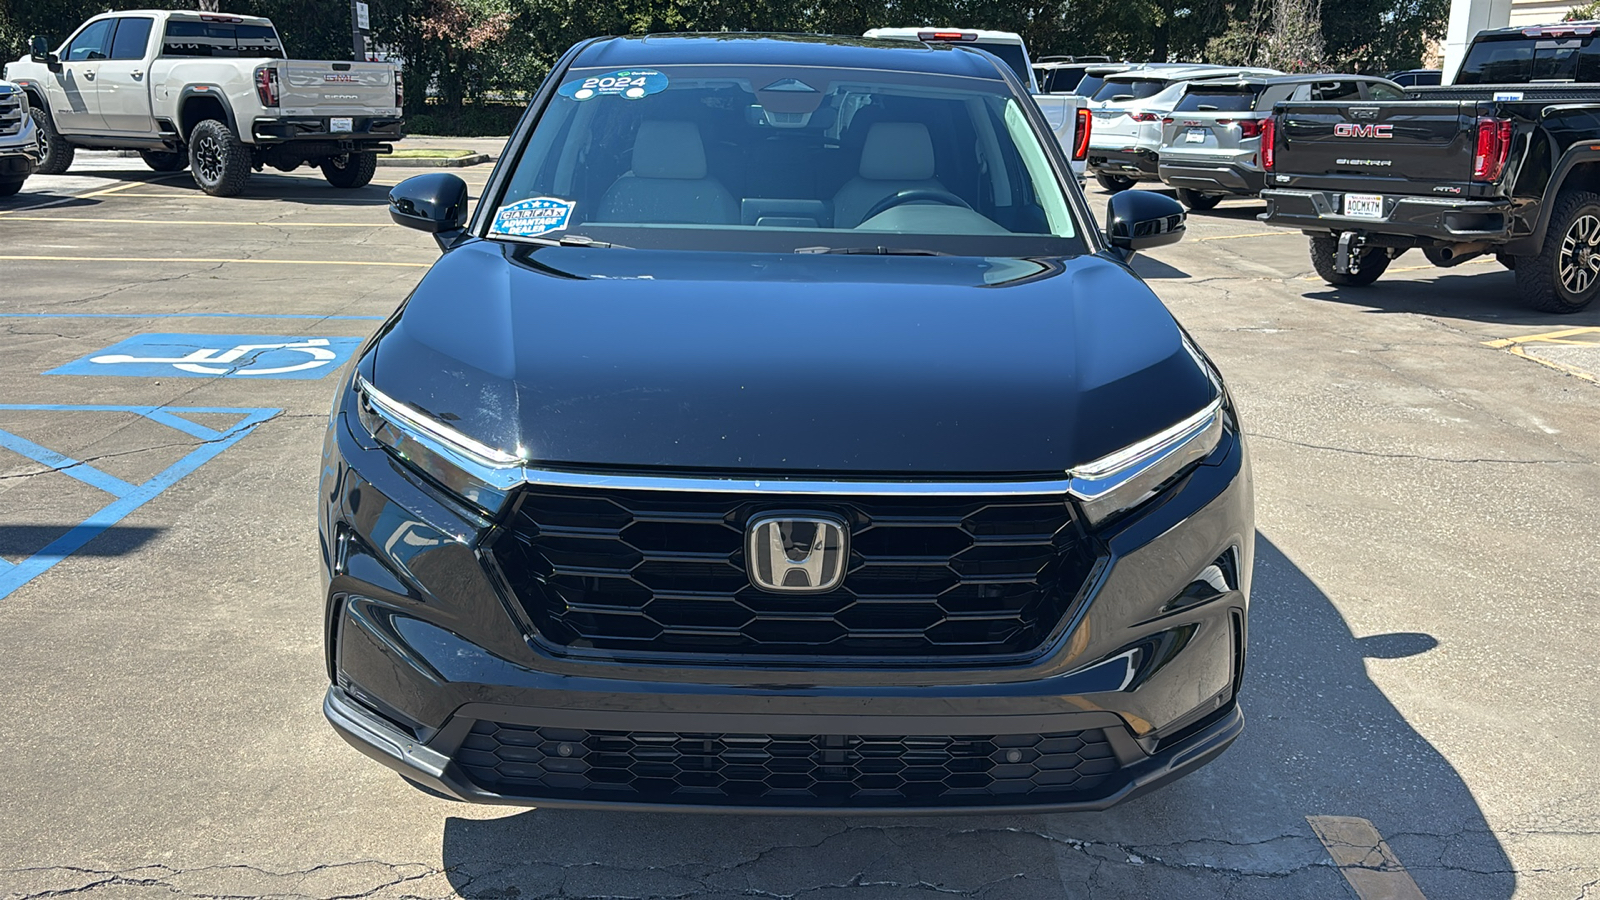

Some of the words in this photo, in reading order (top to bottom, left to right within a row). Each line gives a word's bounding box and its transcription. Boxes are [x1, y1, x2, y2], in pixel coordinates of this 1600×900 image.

[324, 74, 360, 82] GMC
[582, 76, 647, 89] 2024
[1334, 123, 1394, 138] GMC
[1336, 158, 1392, 166] SIERRA
[1433, 186, 1461, 194] AT4
[502, 208, 564, 219] CARFAX
[501, 218, 557, 228] ADVANTAGE
[508, 226, 546, 234] DEALER
